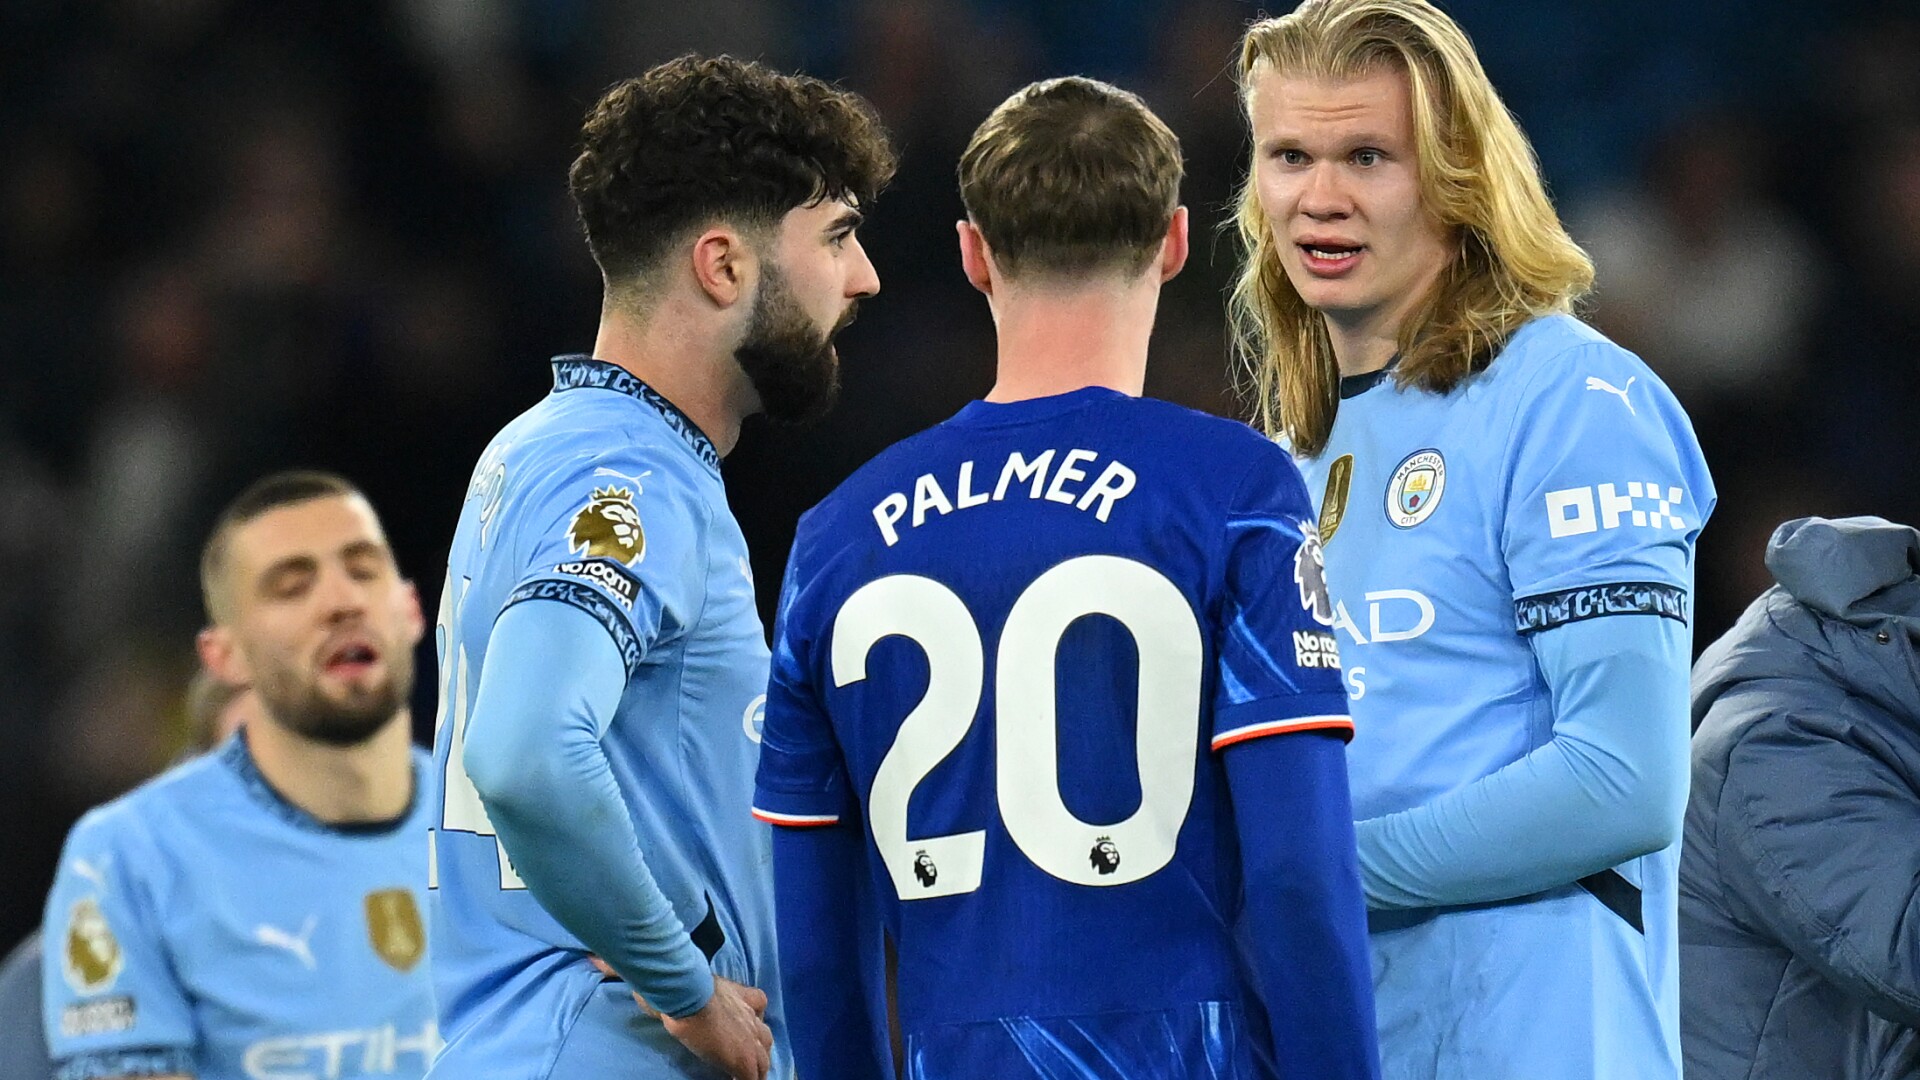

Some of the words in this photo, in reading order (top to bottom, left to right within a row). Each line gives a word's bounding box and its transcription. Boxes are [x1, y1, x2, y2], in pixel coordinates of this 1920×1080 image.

[1397, 456, 1443, 480] MANCHESTER
[872, 448, 1136, 546] PALMER
[1545, 481, 1686, 539] OKX
[1401, 516, 1418, 524] CITY
[583, 562, 632, 596] room
[1292, 631, 1319, 652] No
[831, 554, 1203, 900] 20
[242, 1023, 449, 1080] ETIH
